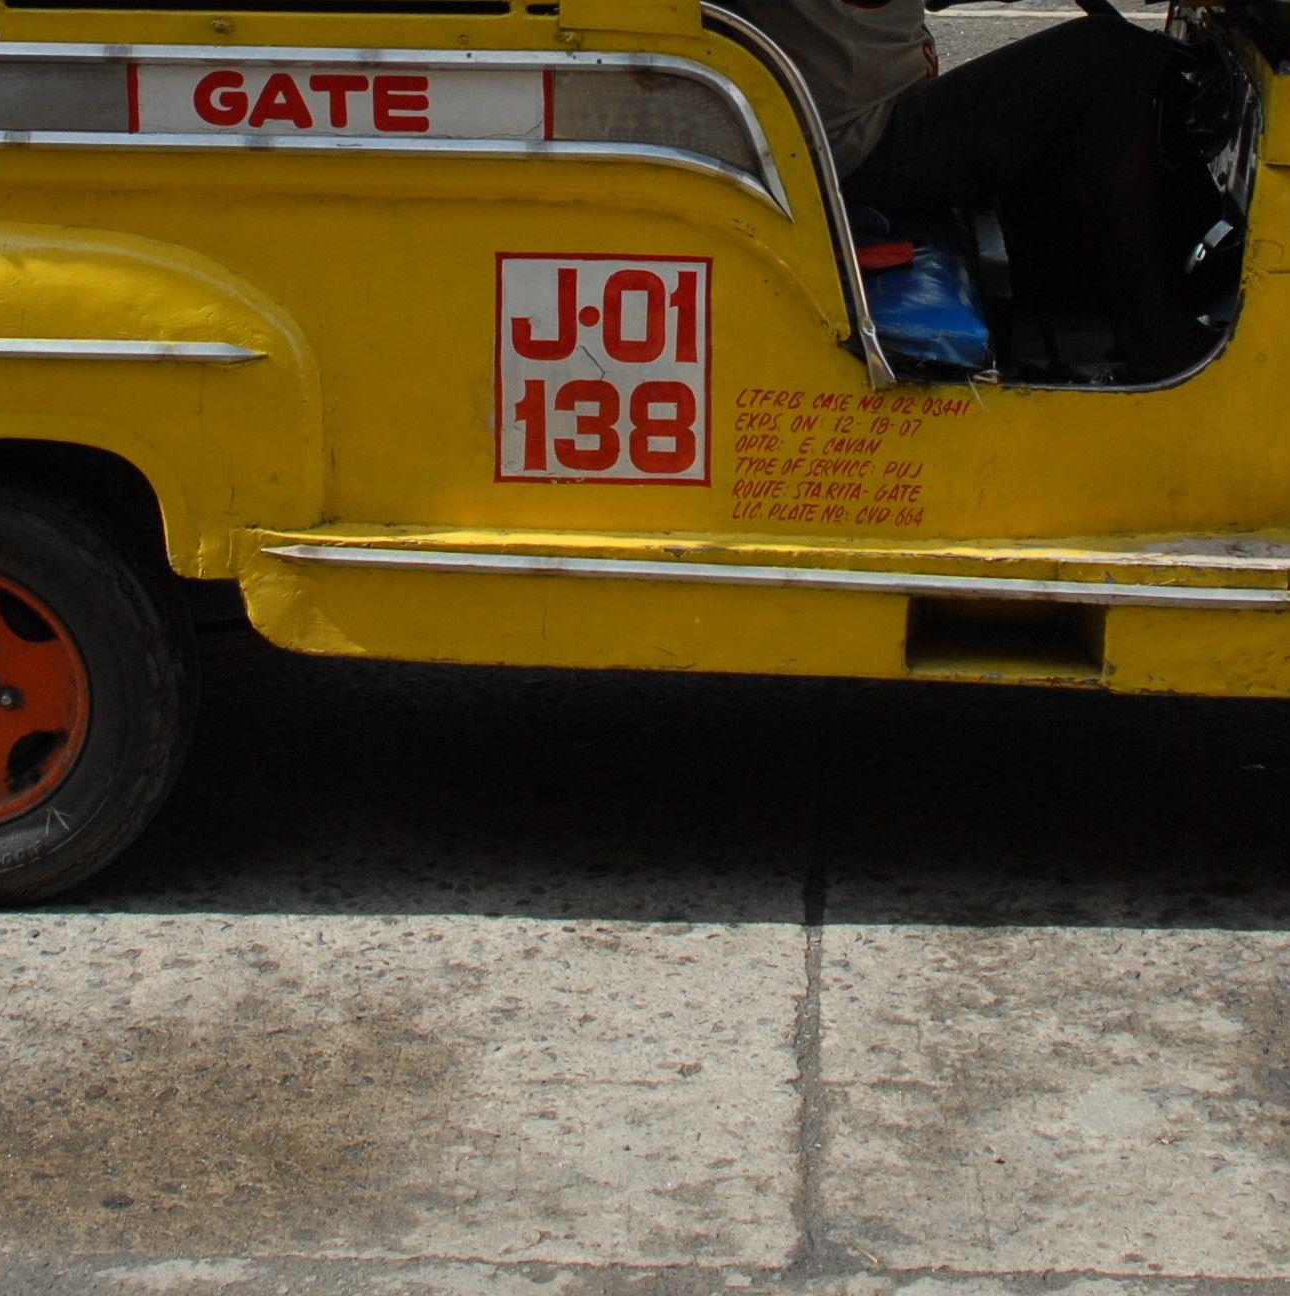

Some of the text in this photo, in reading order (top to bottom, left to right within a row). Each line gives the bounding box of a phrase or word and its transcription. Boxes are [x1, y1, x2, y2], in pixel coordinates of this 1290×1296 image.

[193, 70, 431, 133] GATE
[736, 388, 805, 409] LTFRB
[813, 393, 854, 412] CASE
[515, 379, 697, 474] 138
[822, 437, 883, 455] CAVAN
[735, 456, 924, 479] TYPE OF SERVICE: PUJ
[732, 478, 789, 499] ROUTE:
[874, 483, 923, 503] GATE
[768, 503, 819, 522] PLATE
[856, 506, 925, 527] CVD-664
